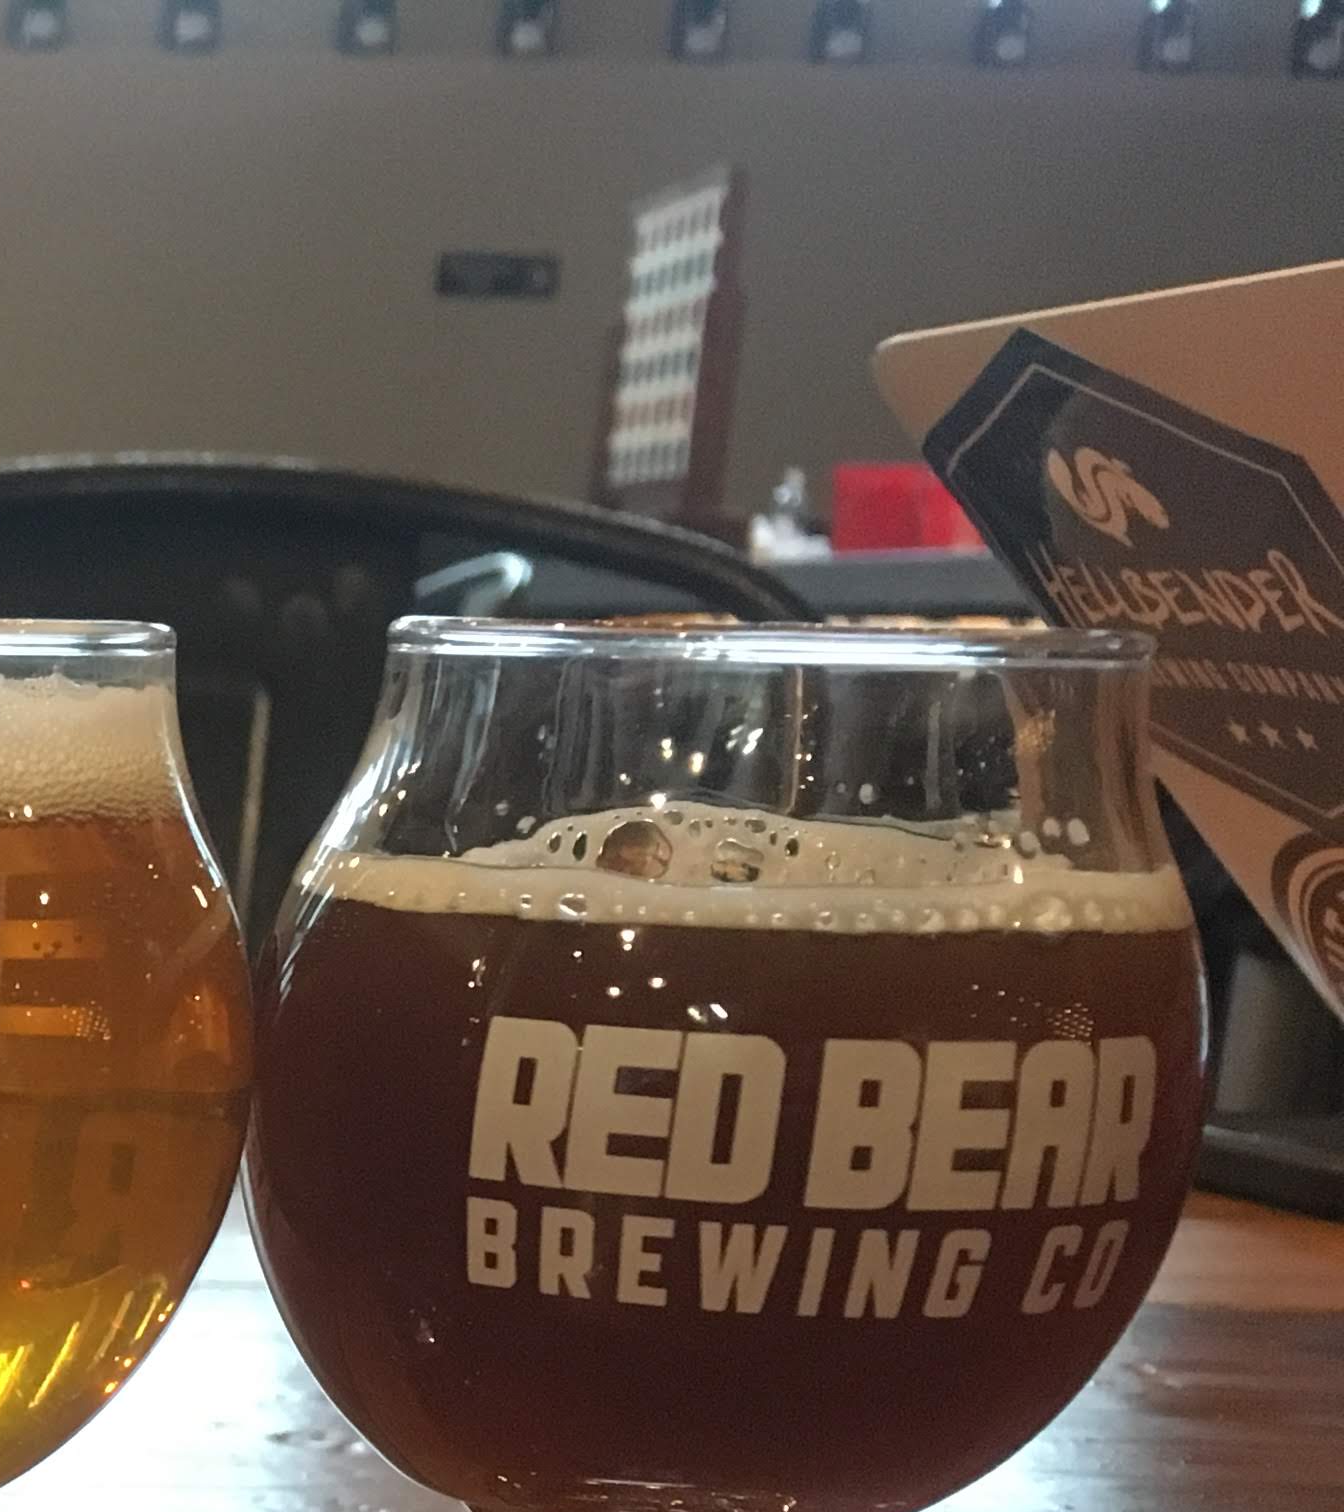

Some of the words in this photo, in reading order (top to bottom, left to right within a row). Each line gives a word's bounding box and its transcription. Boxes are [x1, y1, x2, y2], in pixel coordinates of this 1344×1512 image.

[1025, 543, 1344, 637] HELLBENDER
[468, 1015, 787, 1204] RED
[803, 1035, 1157, 1211] BEAR
[466, 1196, 992, 1319] BREWING
[1020, 1219, 1130, 1315] CO
